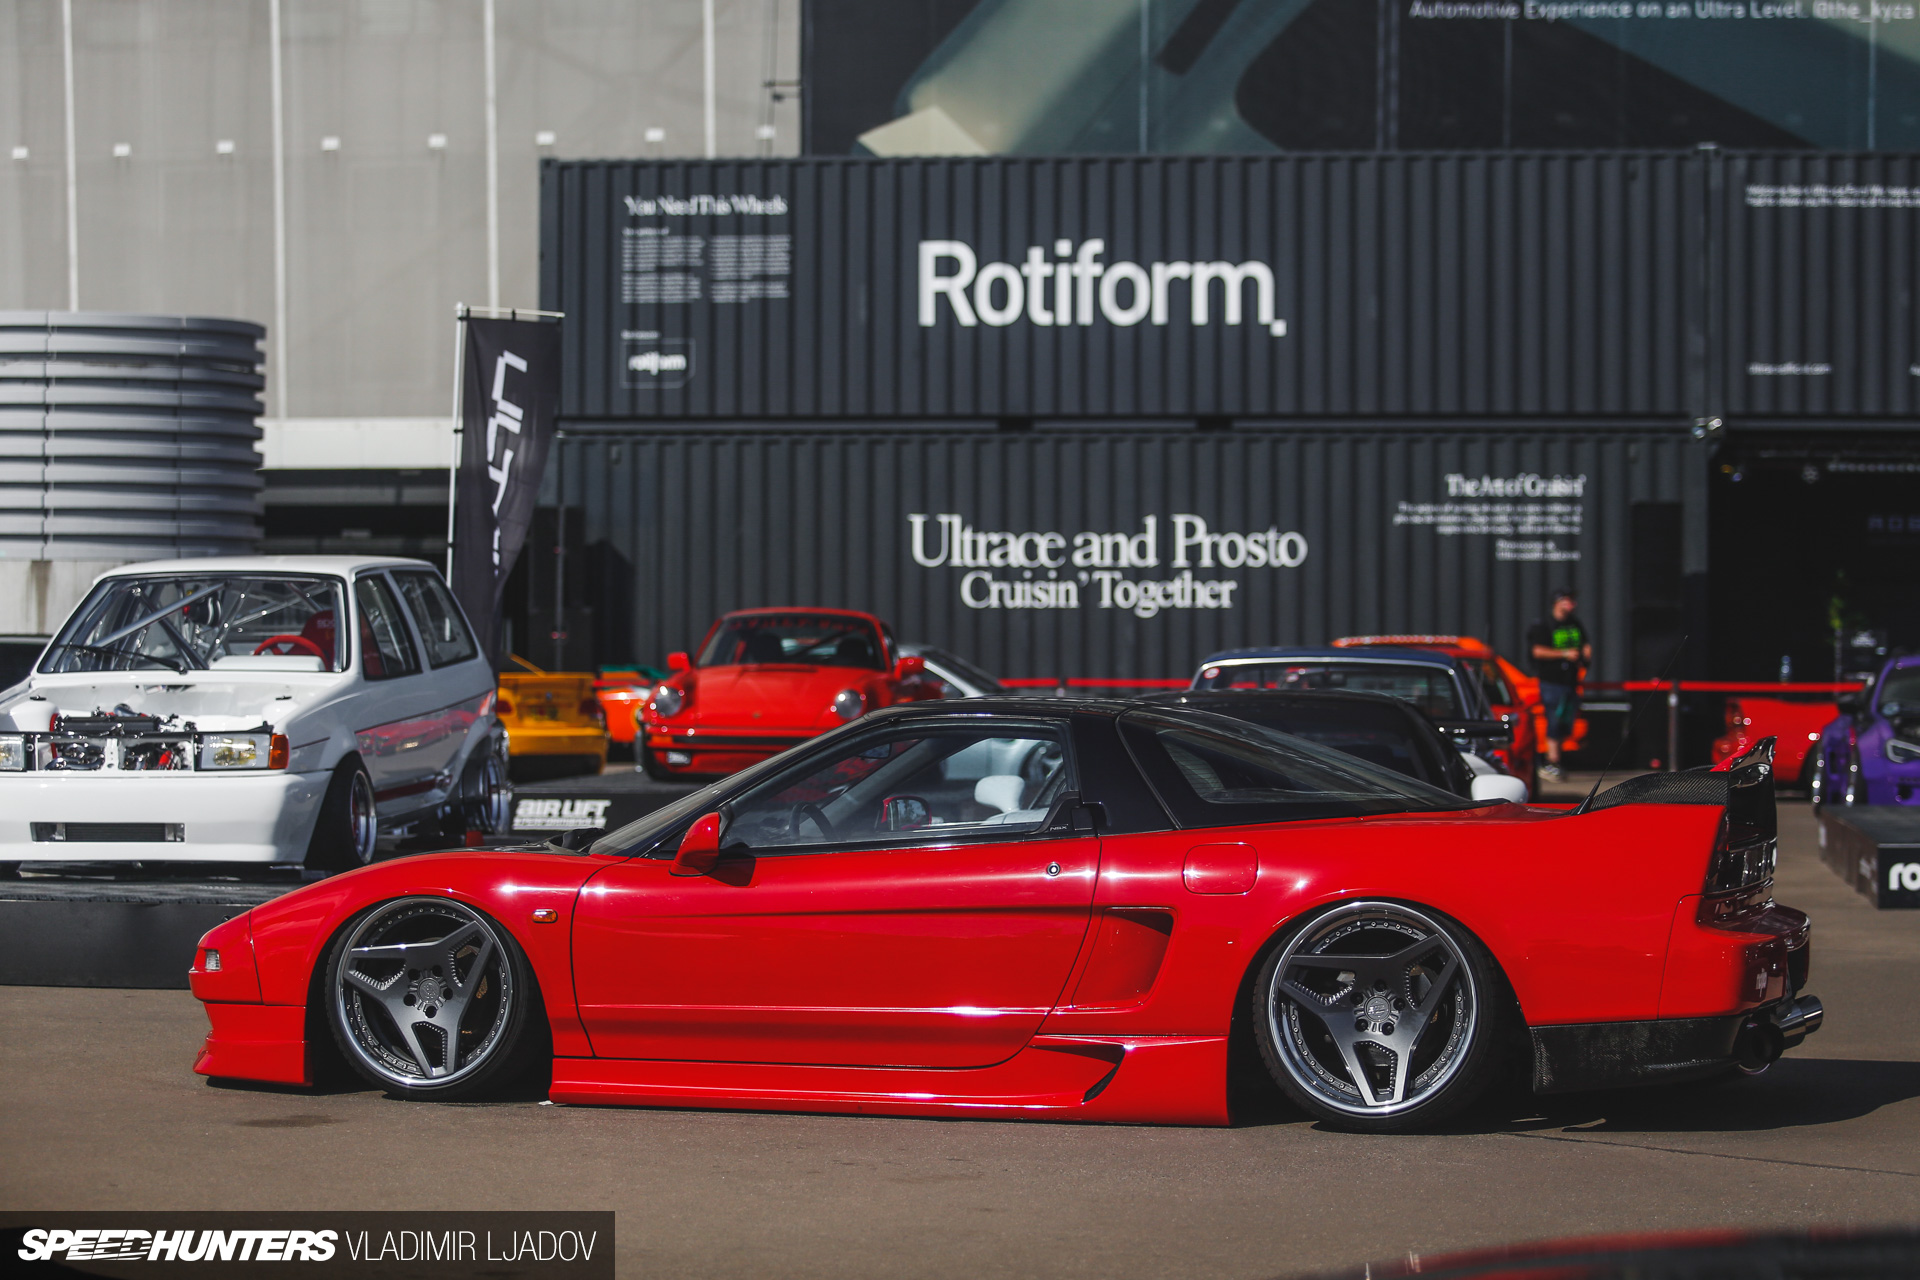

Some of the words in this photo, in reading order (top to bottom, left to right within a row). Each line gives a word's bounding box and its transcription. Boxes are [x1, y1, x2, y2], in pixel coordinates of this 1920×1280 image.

[1524, 0, 1633, 22] Experience
[1636, 4, 1661, 18] on
[1665, 4, 1692, 18] an
[1695, 0, 1746, 19] Ultra
[907, 513, 1067, 568] Ultrace
[1072, 513, 1160, 568] and
[1170, 513, 1309, 568] Prosto
[1091, 569, 1238, 618] Together
